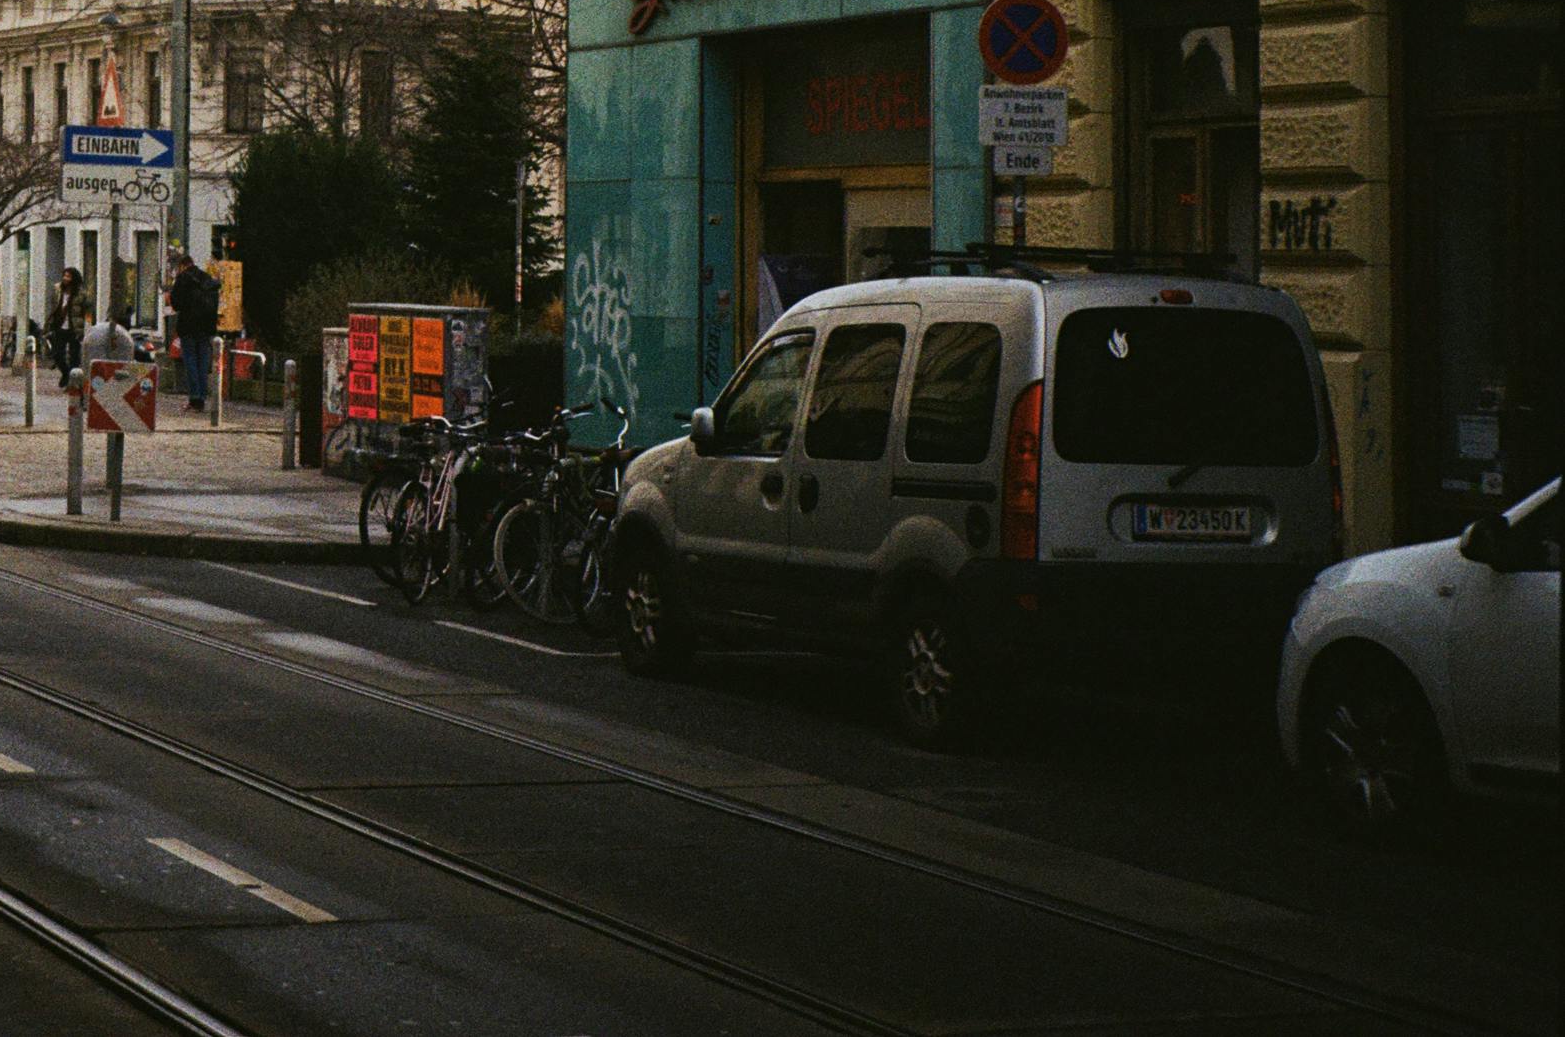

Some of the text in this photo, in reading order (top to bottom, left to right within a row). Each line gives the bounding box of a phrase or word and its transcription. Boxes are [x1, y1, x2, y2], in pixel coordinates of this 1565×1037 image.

[983, 88, 1065, 100] Anwohnerparken
[805, 72, 931, 135] SPIEGEL
[1014, 102, 1044, 113] Bezirk
[1010, 117, 1055, 128] Amtsblatt
[77, 136, 140, 155] EINBAHN
[1006, 152, 1040, 168] Ende
[1148, 509, 1246, 531] W 23450K
